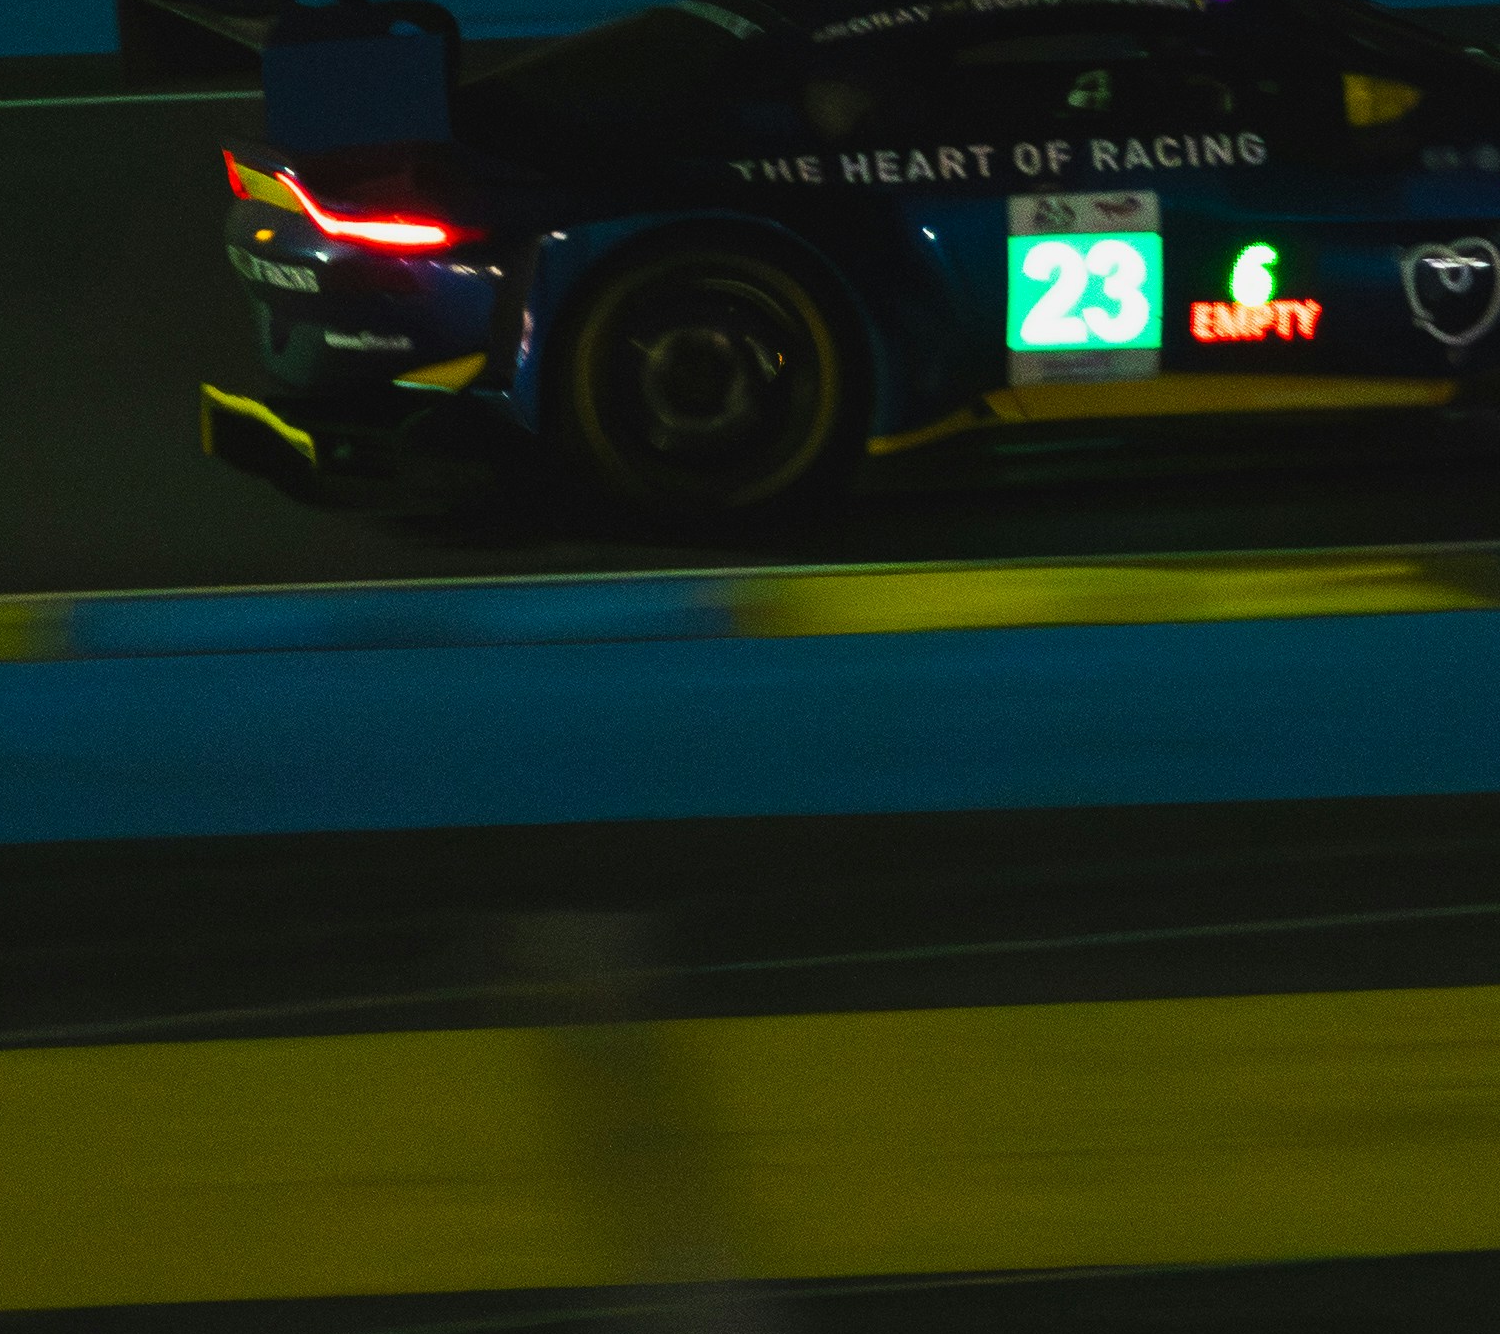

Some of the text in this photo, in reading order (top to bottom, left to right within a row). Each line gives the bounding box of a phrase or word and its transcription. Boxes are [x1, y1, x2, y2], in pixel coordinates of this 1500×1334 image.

[727, 131, 1268, 186] THE HEART OF RACING
[1019, 238, 1152, 346] 23
[1230, 242, 1279, 307] 6
[1189, 298, 1323, 344] EMPTY
